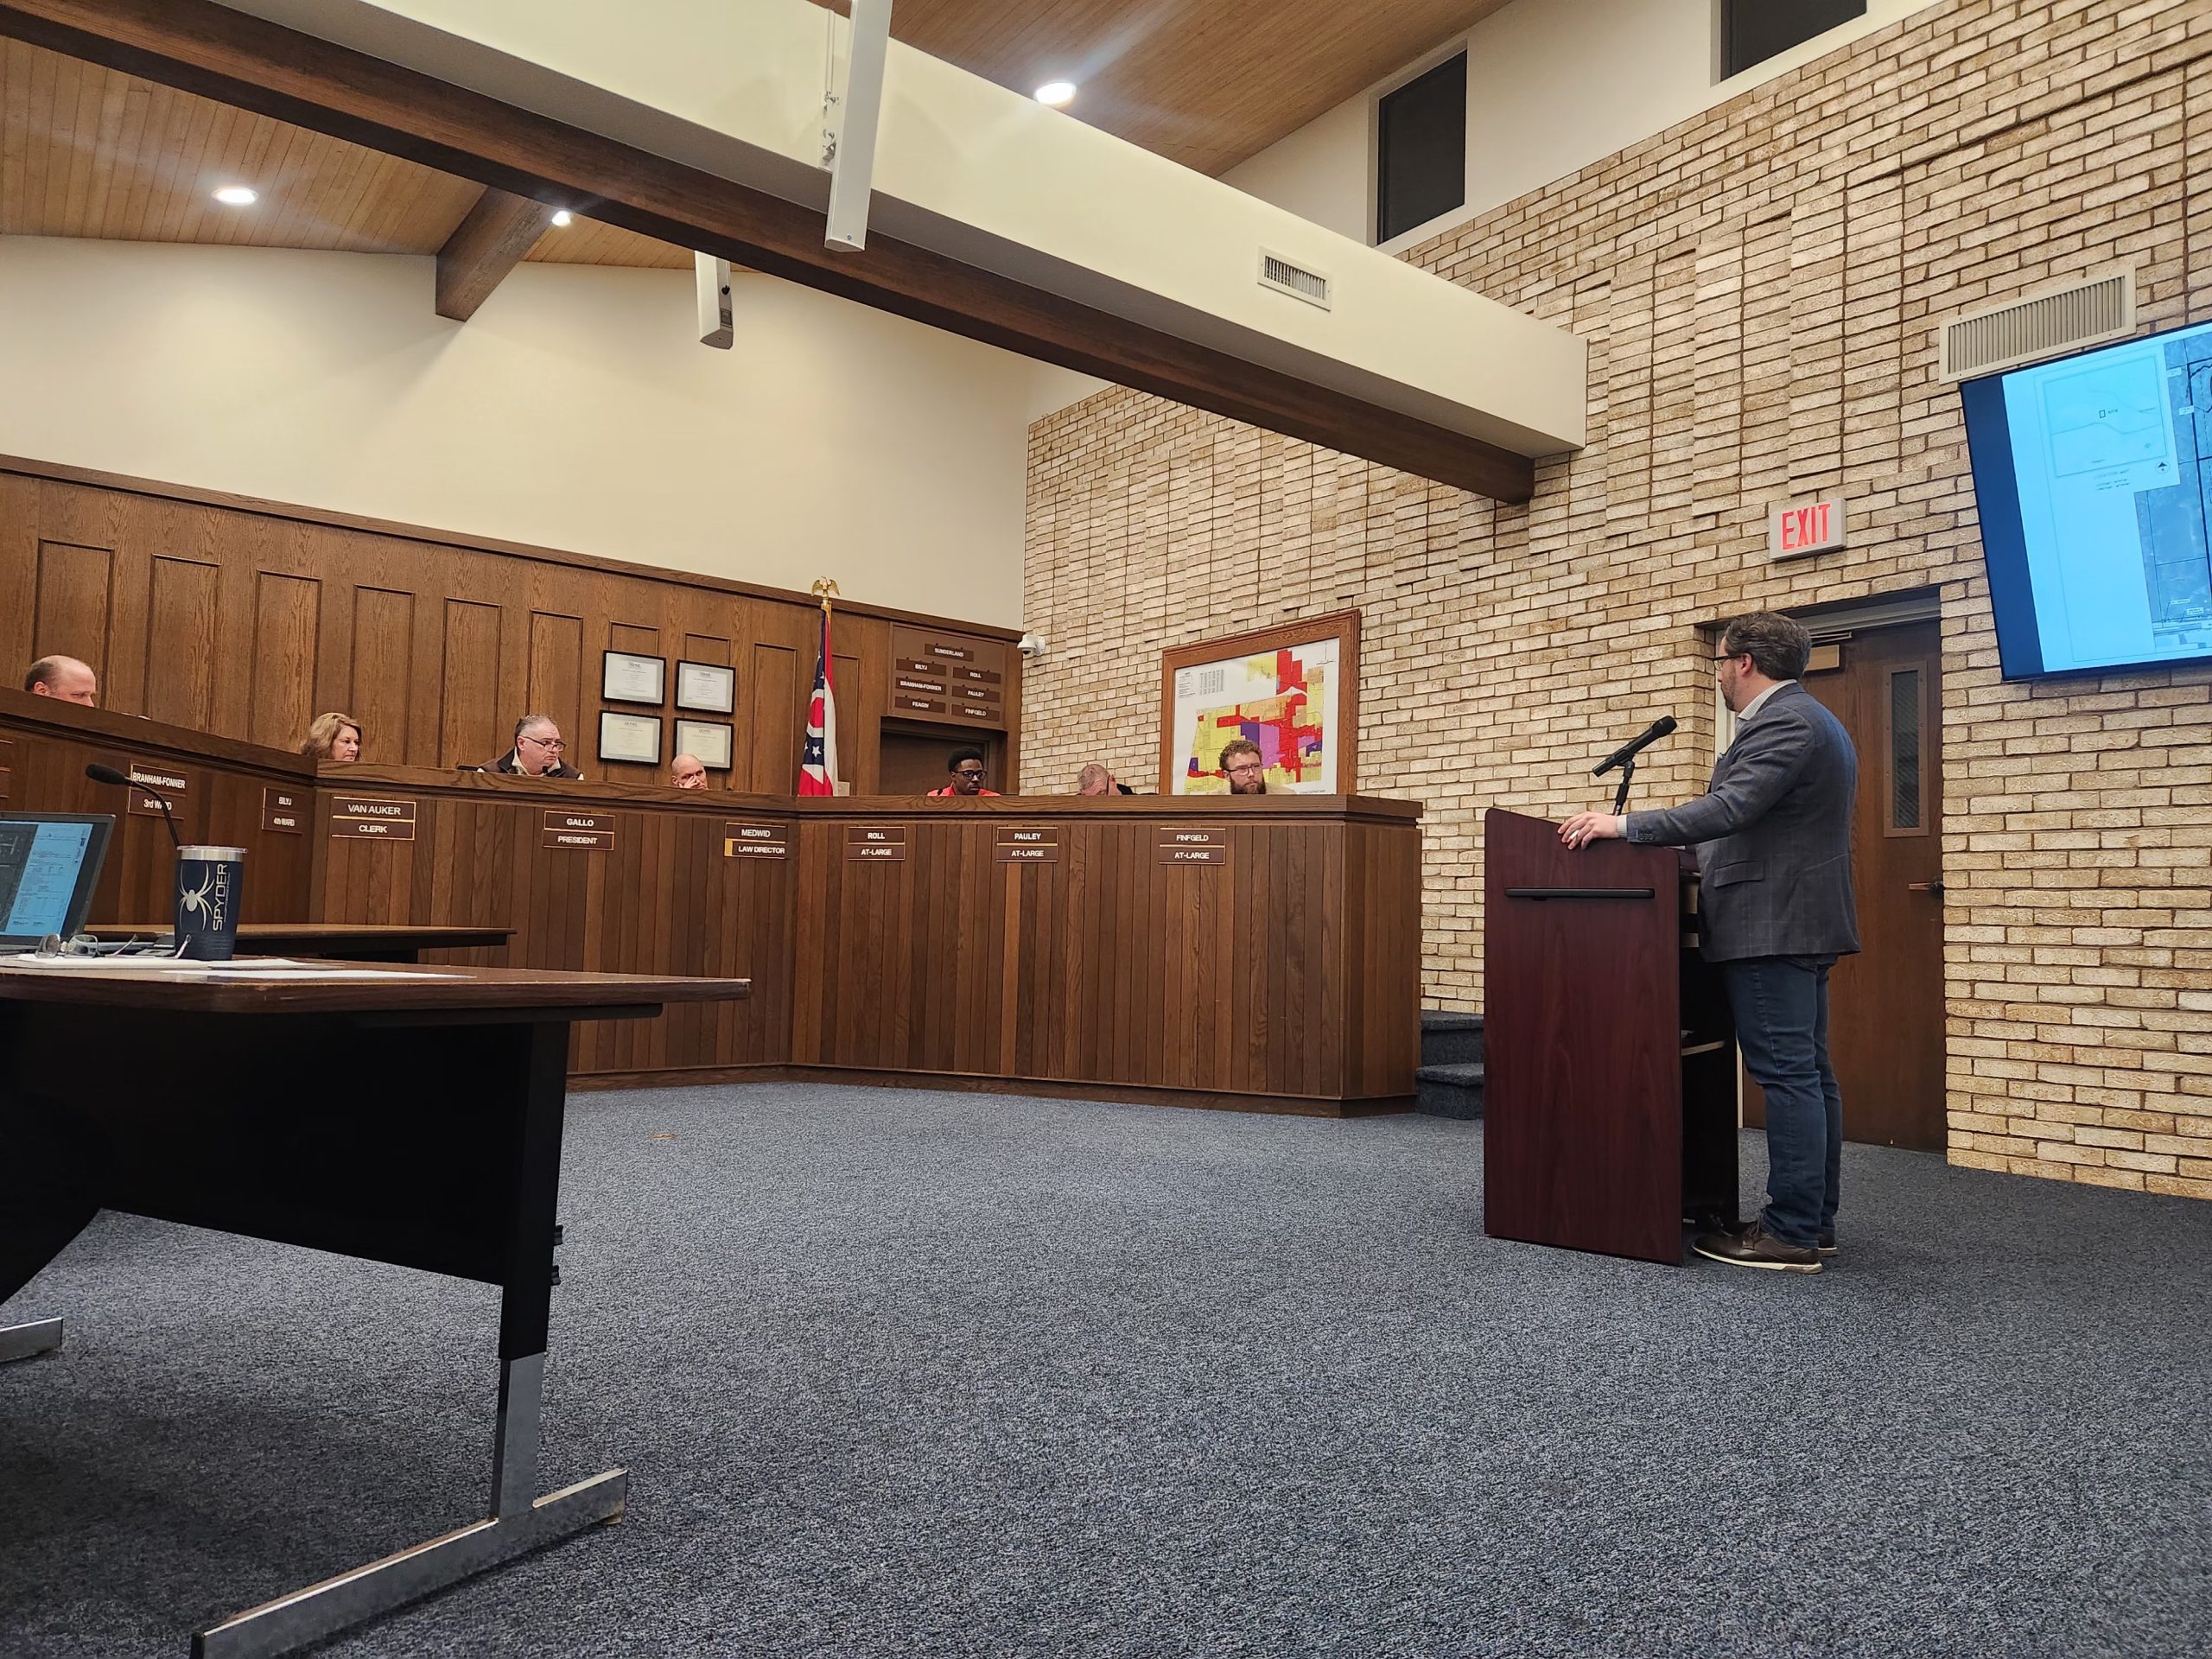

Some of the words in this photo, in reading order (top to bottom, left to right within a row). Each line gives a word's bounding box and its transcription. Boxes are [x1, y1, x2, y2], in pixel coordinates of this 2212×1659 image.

[1782, 503, 1831, 550] EXIT
[132, 772, 186, 789] BRANHAM-FONNER
[143, 798, 154, 809] 3rd
[154, 799, 173, 810] WD
[347, 804, 367, 814] VAN
[368, 805, 401, 816] AUKER
[566, 818, 594, 827] GALLO
[359, 824, 387, 834] CLERK
[741, 828, 771, 838] MEDWID
[557, 835, 598, 845] PRESIDENT
[867, 832, 886, 841] ROLL
[1014, 832, 1042, 841] PAULEY
[1176, 834, 1209, 842] FINFGELD
[738, 845, 753, 854] LAW
[753, 846, 785, 855] DIRECTOR
[861, 848, 893, 856] AT-LARGE
[1011, 849, 1045, 858] AT-LARGE
[1174, 851, 1210, 860] AT-LARGE
[213, 863, 228, 931] SPYDER
